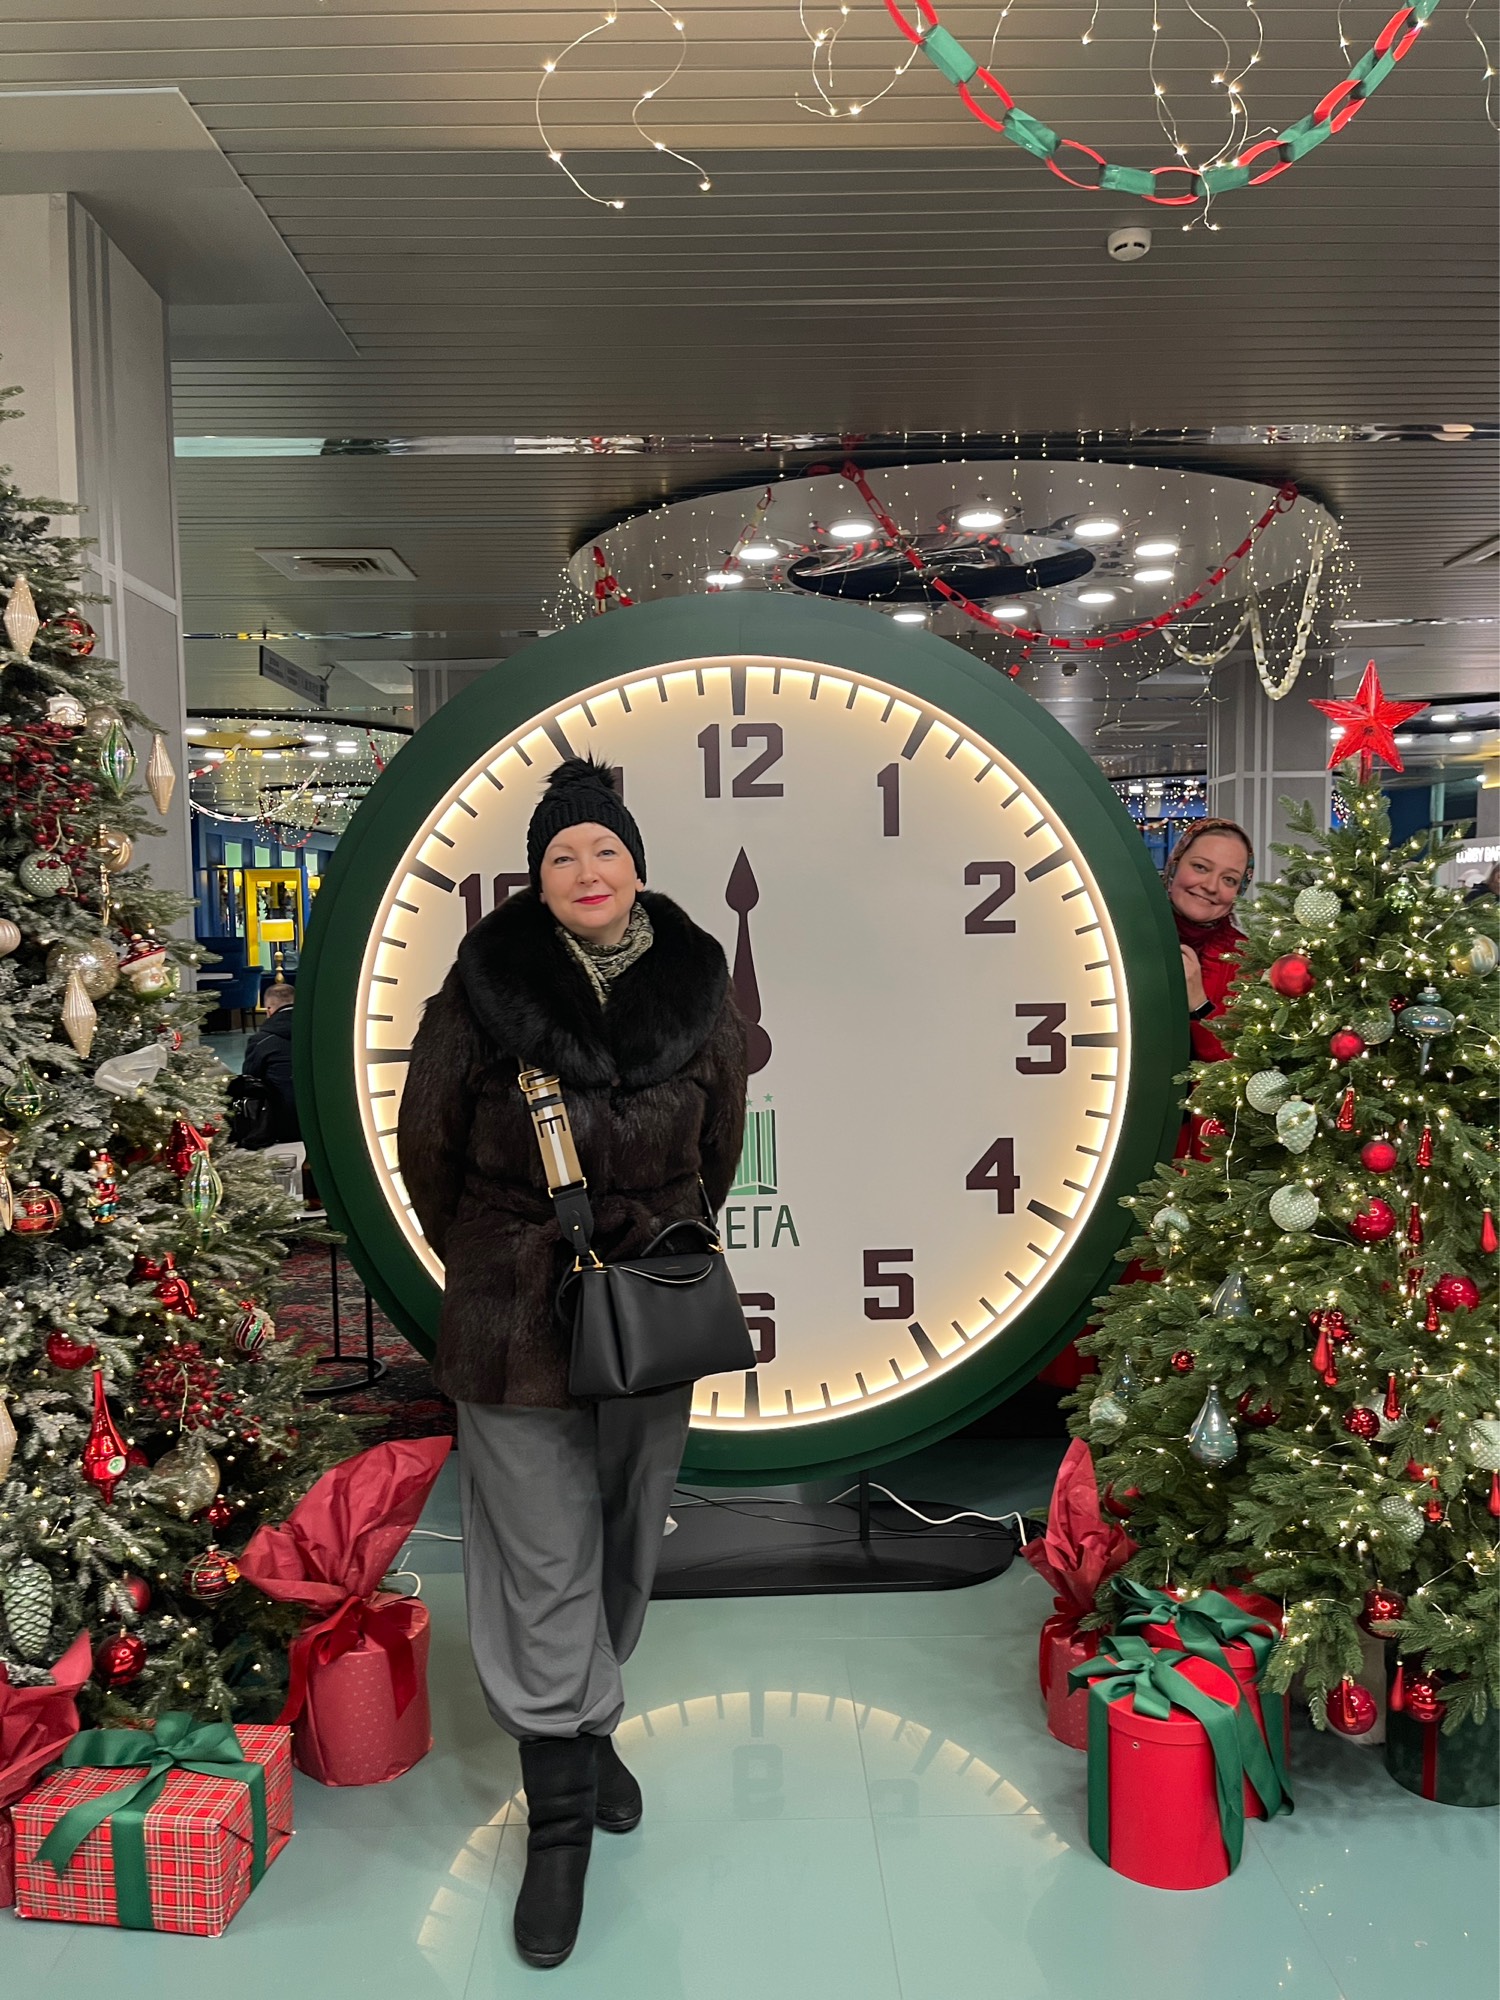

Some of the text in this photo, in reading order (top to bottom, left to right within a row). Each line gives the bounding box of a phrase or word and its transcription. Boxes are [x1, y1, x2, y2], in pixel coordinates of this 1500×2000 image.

[698, 723, 784, 798] 12
[877, 763, 900, 837] 1
[459, 873, 529, 933] 1
[964, 861, 1016, 934] 2
[1015, 1003, 1067, 1075] 3
[966, 1137, 1021, 1214] 4
[726, 1205, 800, 1249] ЕГА
[863, 1249, 914, 1320] 5
